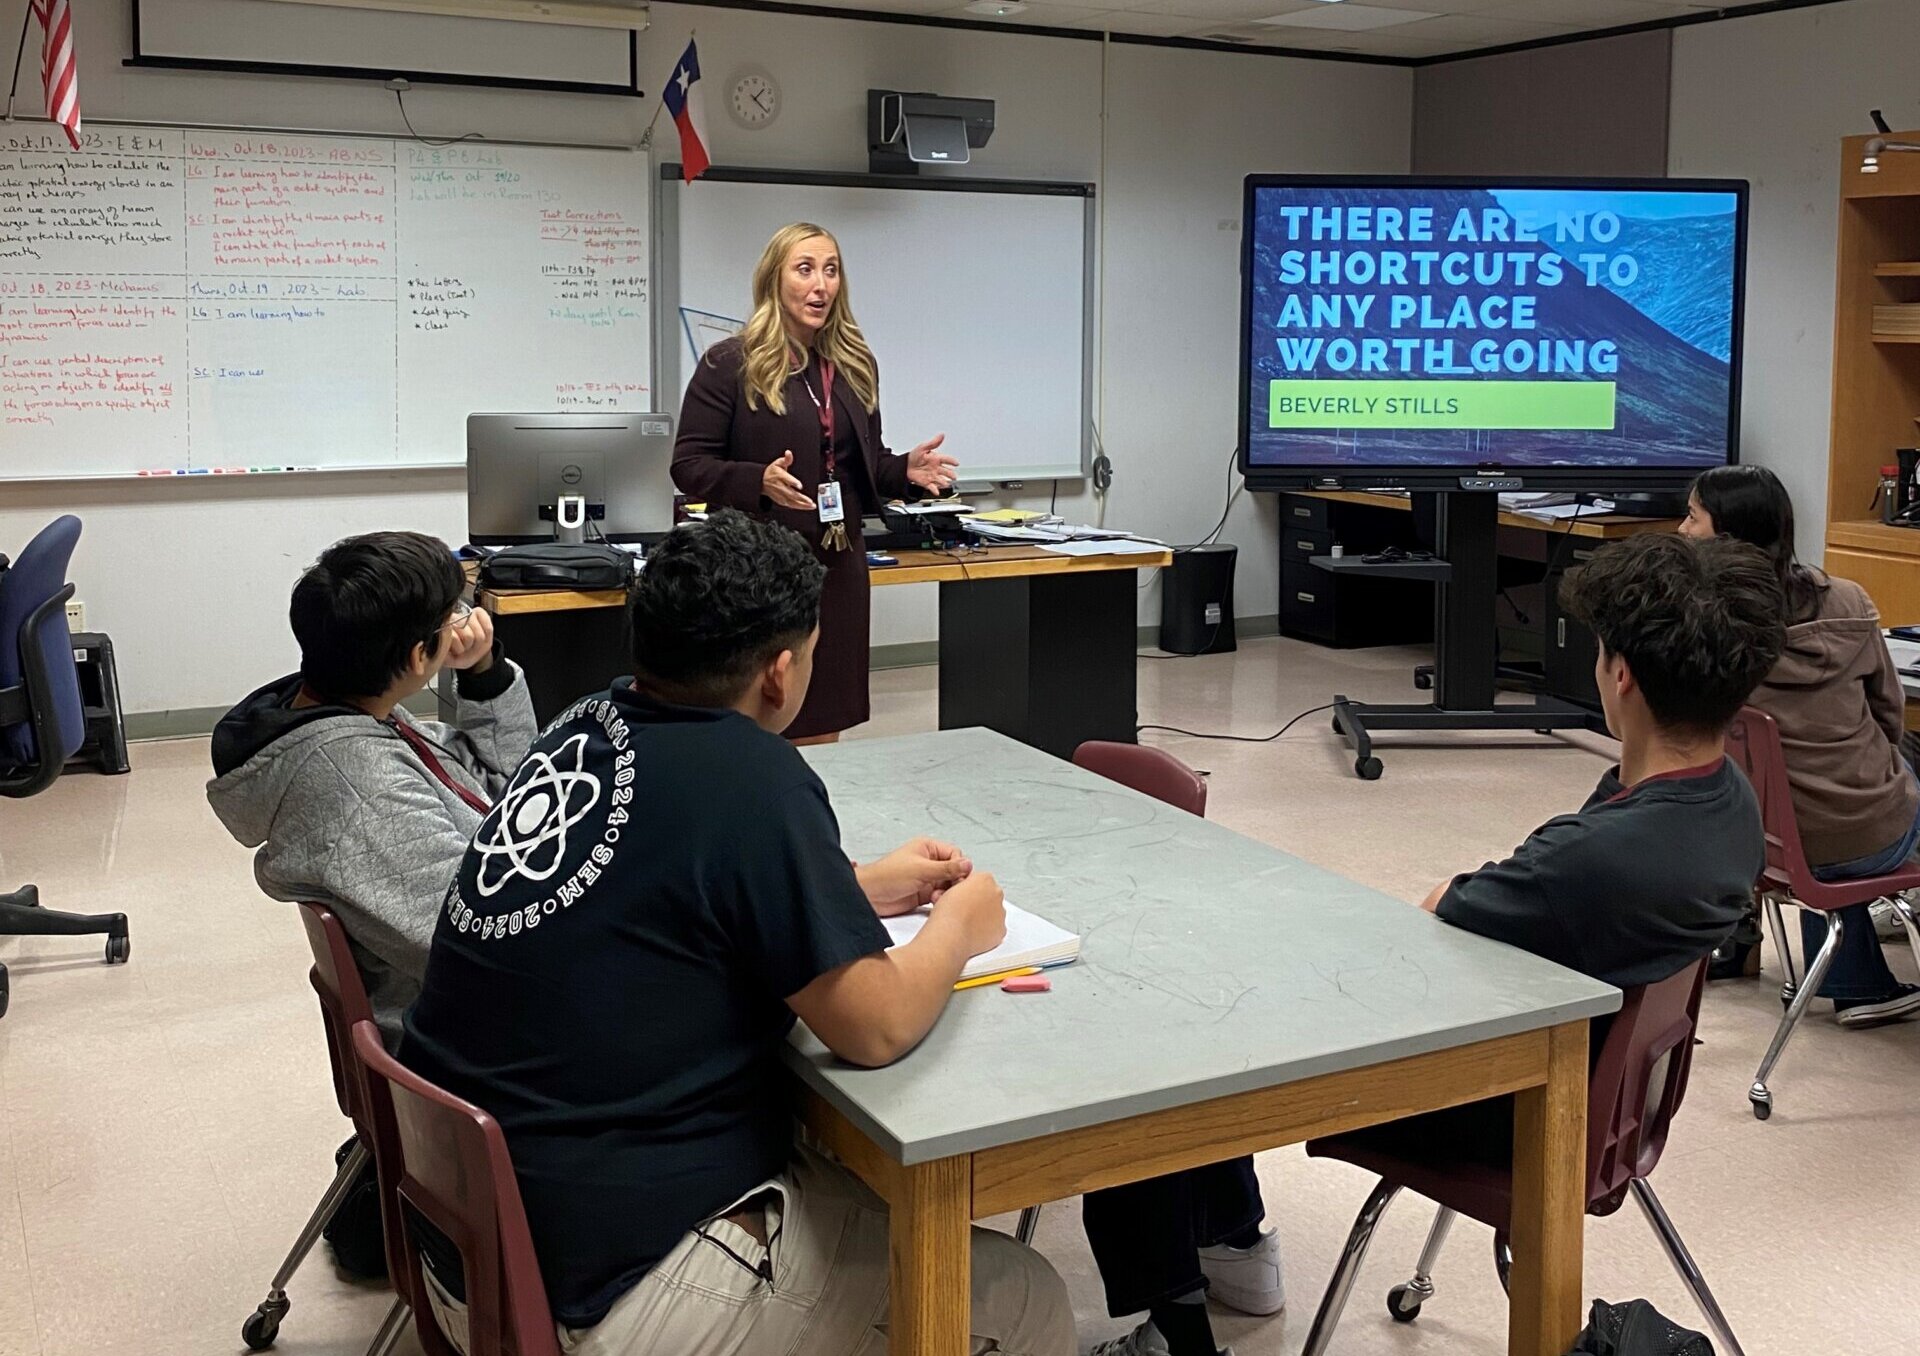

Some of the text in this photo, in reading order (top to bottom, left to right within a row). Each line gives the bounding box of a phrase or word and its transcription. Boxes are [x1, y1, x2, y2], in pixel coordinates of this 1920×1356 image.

[565, 208, 624, 221] Corrections
[1279, 206, 1621, 244] THERE ARE NO
[1277, 250, 1640, 288] SHORTCUTS TO
[250, 308, 293, 322] learning
[1276, 294, 1537, 330] ANY PLACE
[1276, 337, 1619, 374] WORTH GOING
[1279, 397, 1460, 415] BEVERLY STILLS
[606, 749, 637, 827] 2024
[555, 842, 616, 909] SEM
[481, 902, 542, 941] 2024
